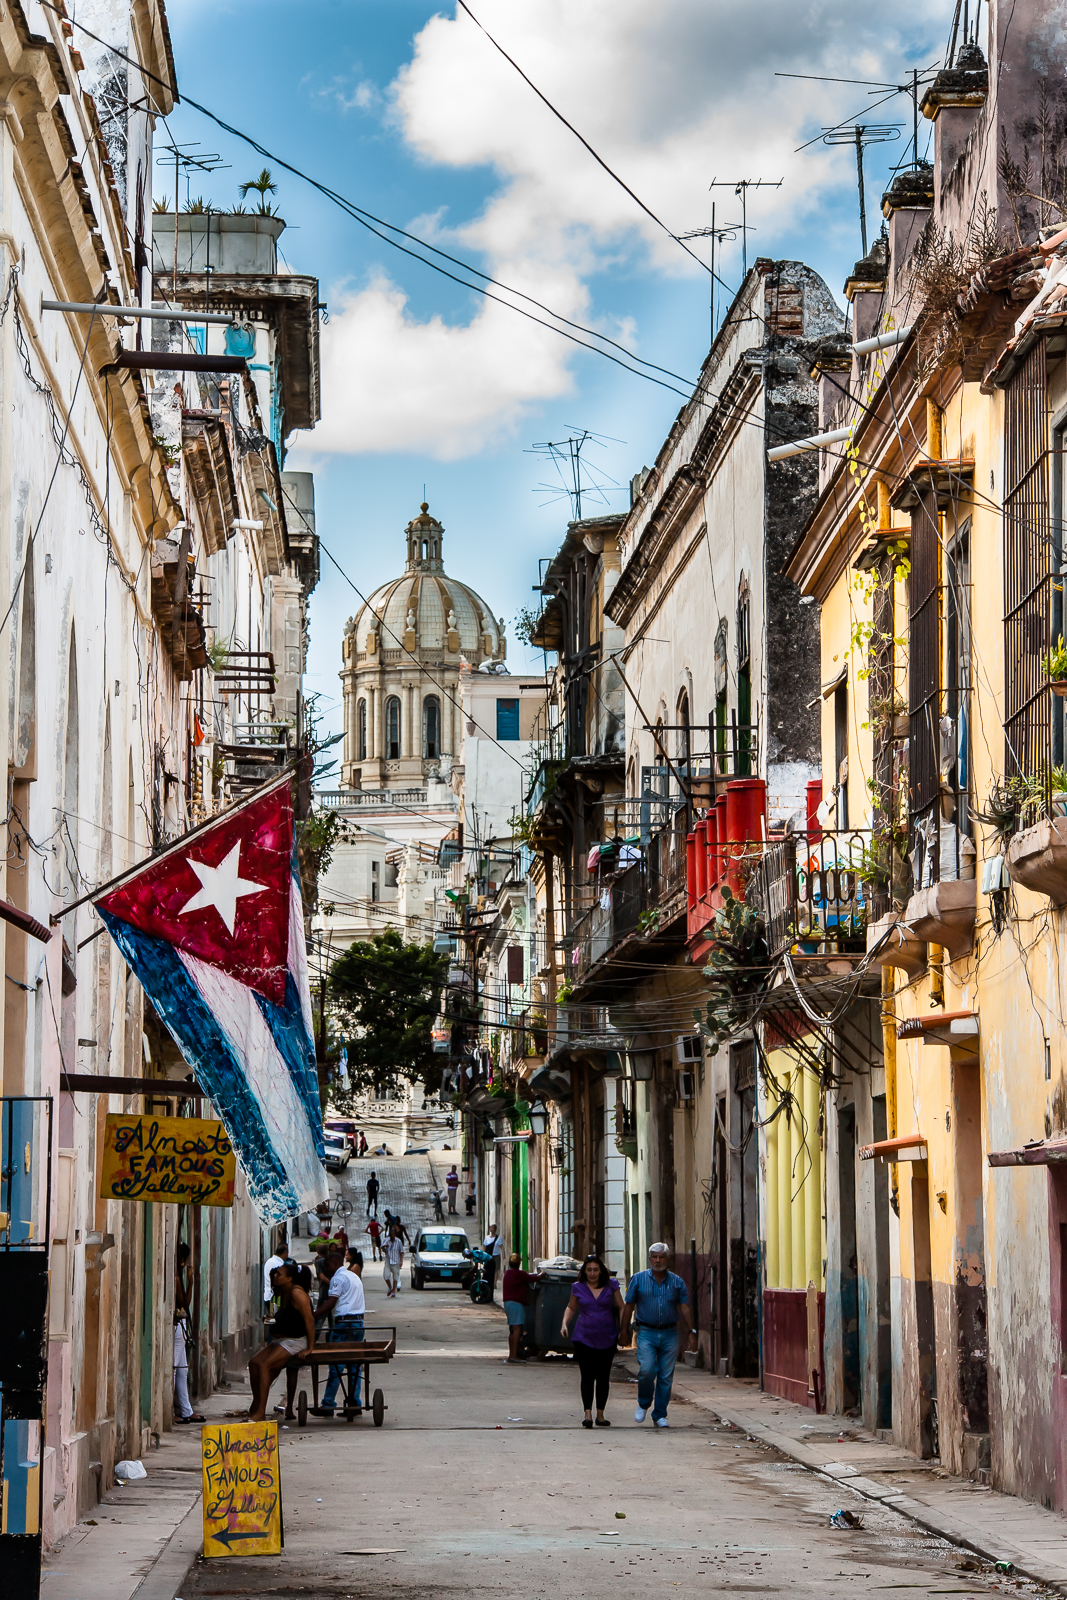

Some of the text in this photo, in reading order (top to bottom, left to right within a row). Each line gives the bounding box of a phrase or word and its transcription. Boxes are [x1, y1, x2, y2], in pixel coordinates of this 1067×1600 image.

[115, 1118, 232, 1155] Almost
[129, 1155, 225, 1177] FAMOUS
[111, 1171, 221, 1204] Gallery
[204, 1428, 277, 1462] Almost
[206, 1462, 274, 1493] FAMOUS
[206, 1488, 278, 1527] Gallery
